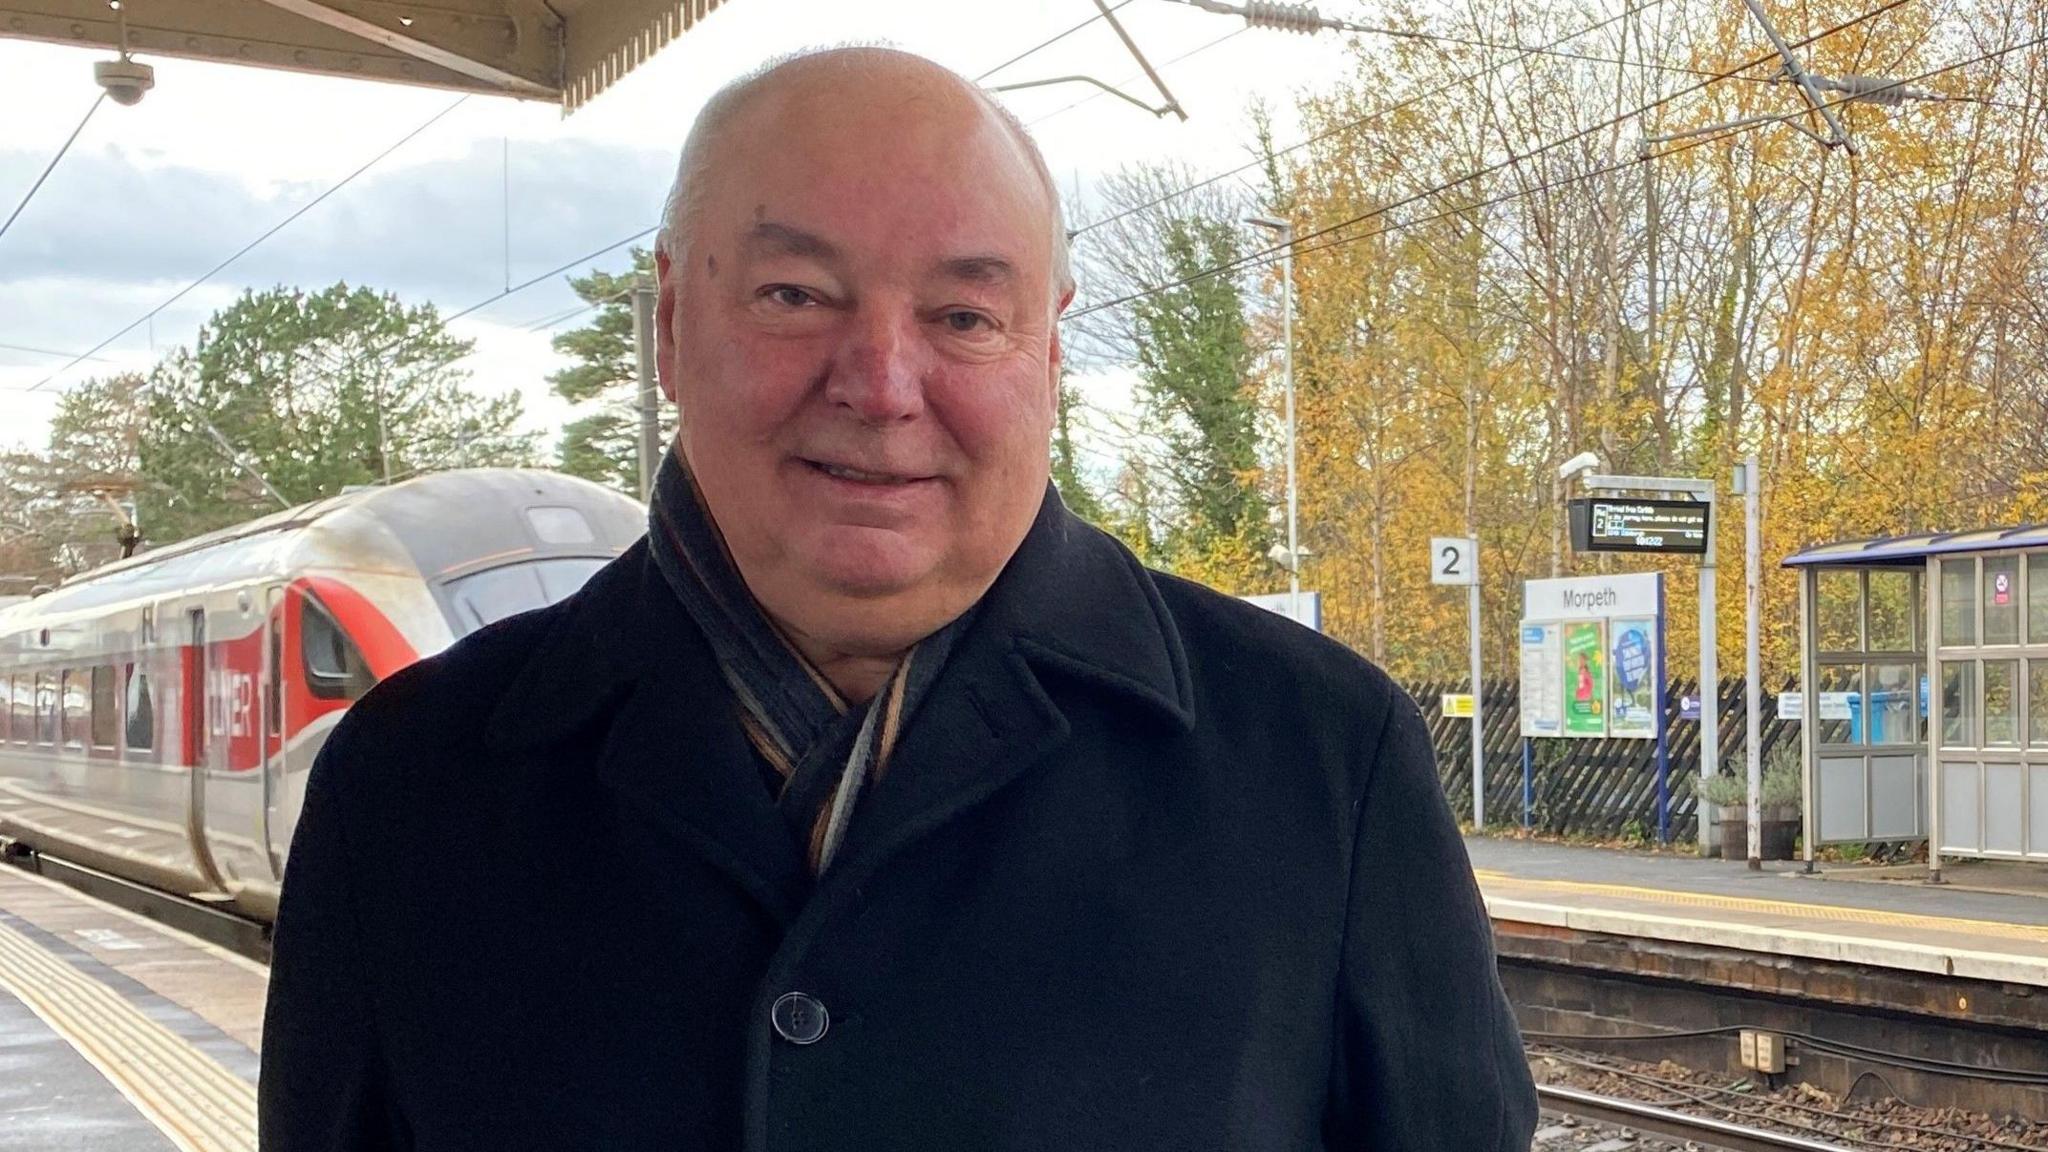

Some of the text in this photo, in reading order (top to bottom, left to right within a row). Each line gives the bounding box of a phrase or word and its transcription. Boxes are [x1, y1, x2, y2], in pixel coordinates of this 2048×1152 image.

[1596, 518, 1605, 529] 2
[1441, 546, 1460, 575] 2
[1563, 588, 1616, 611] Morpeth
